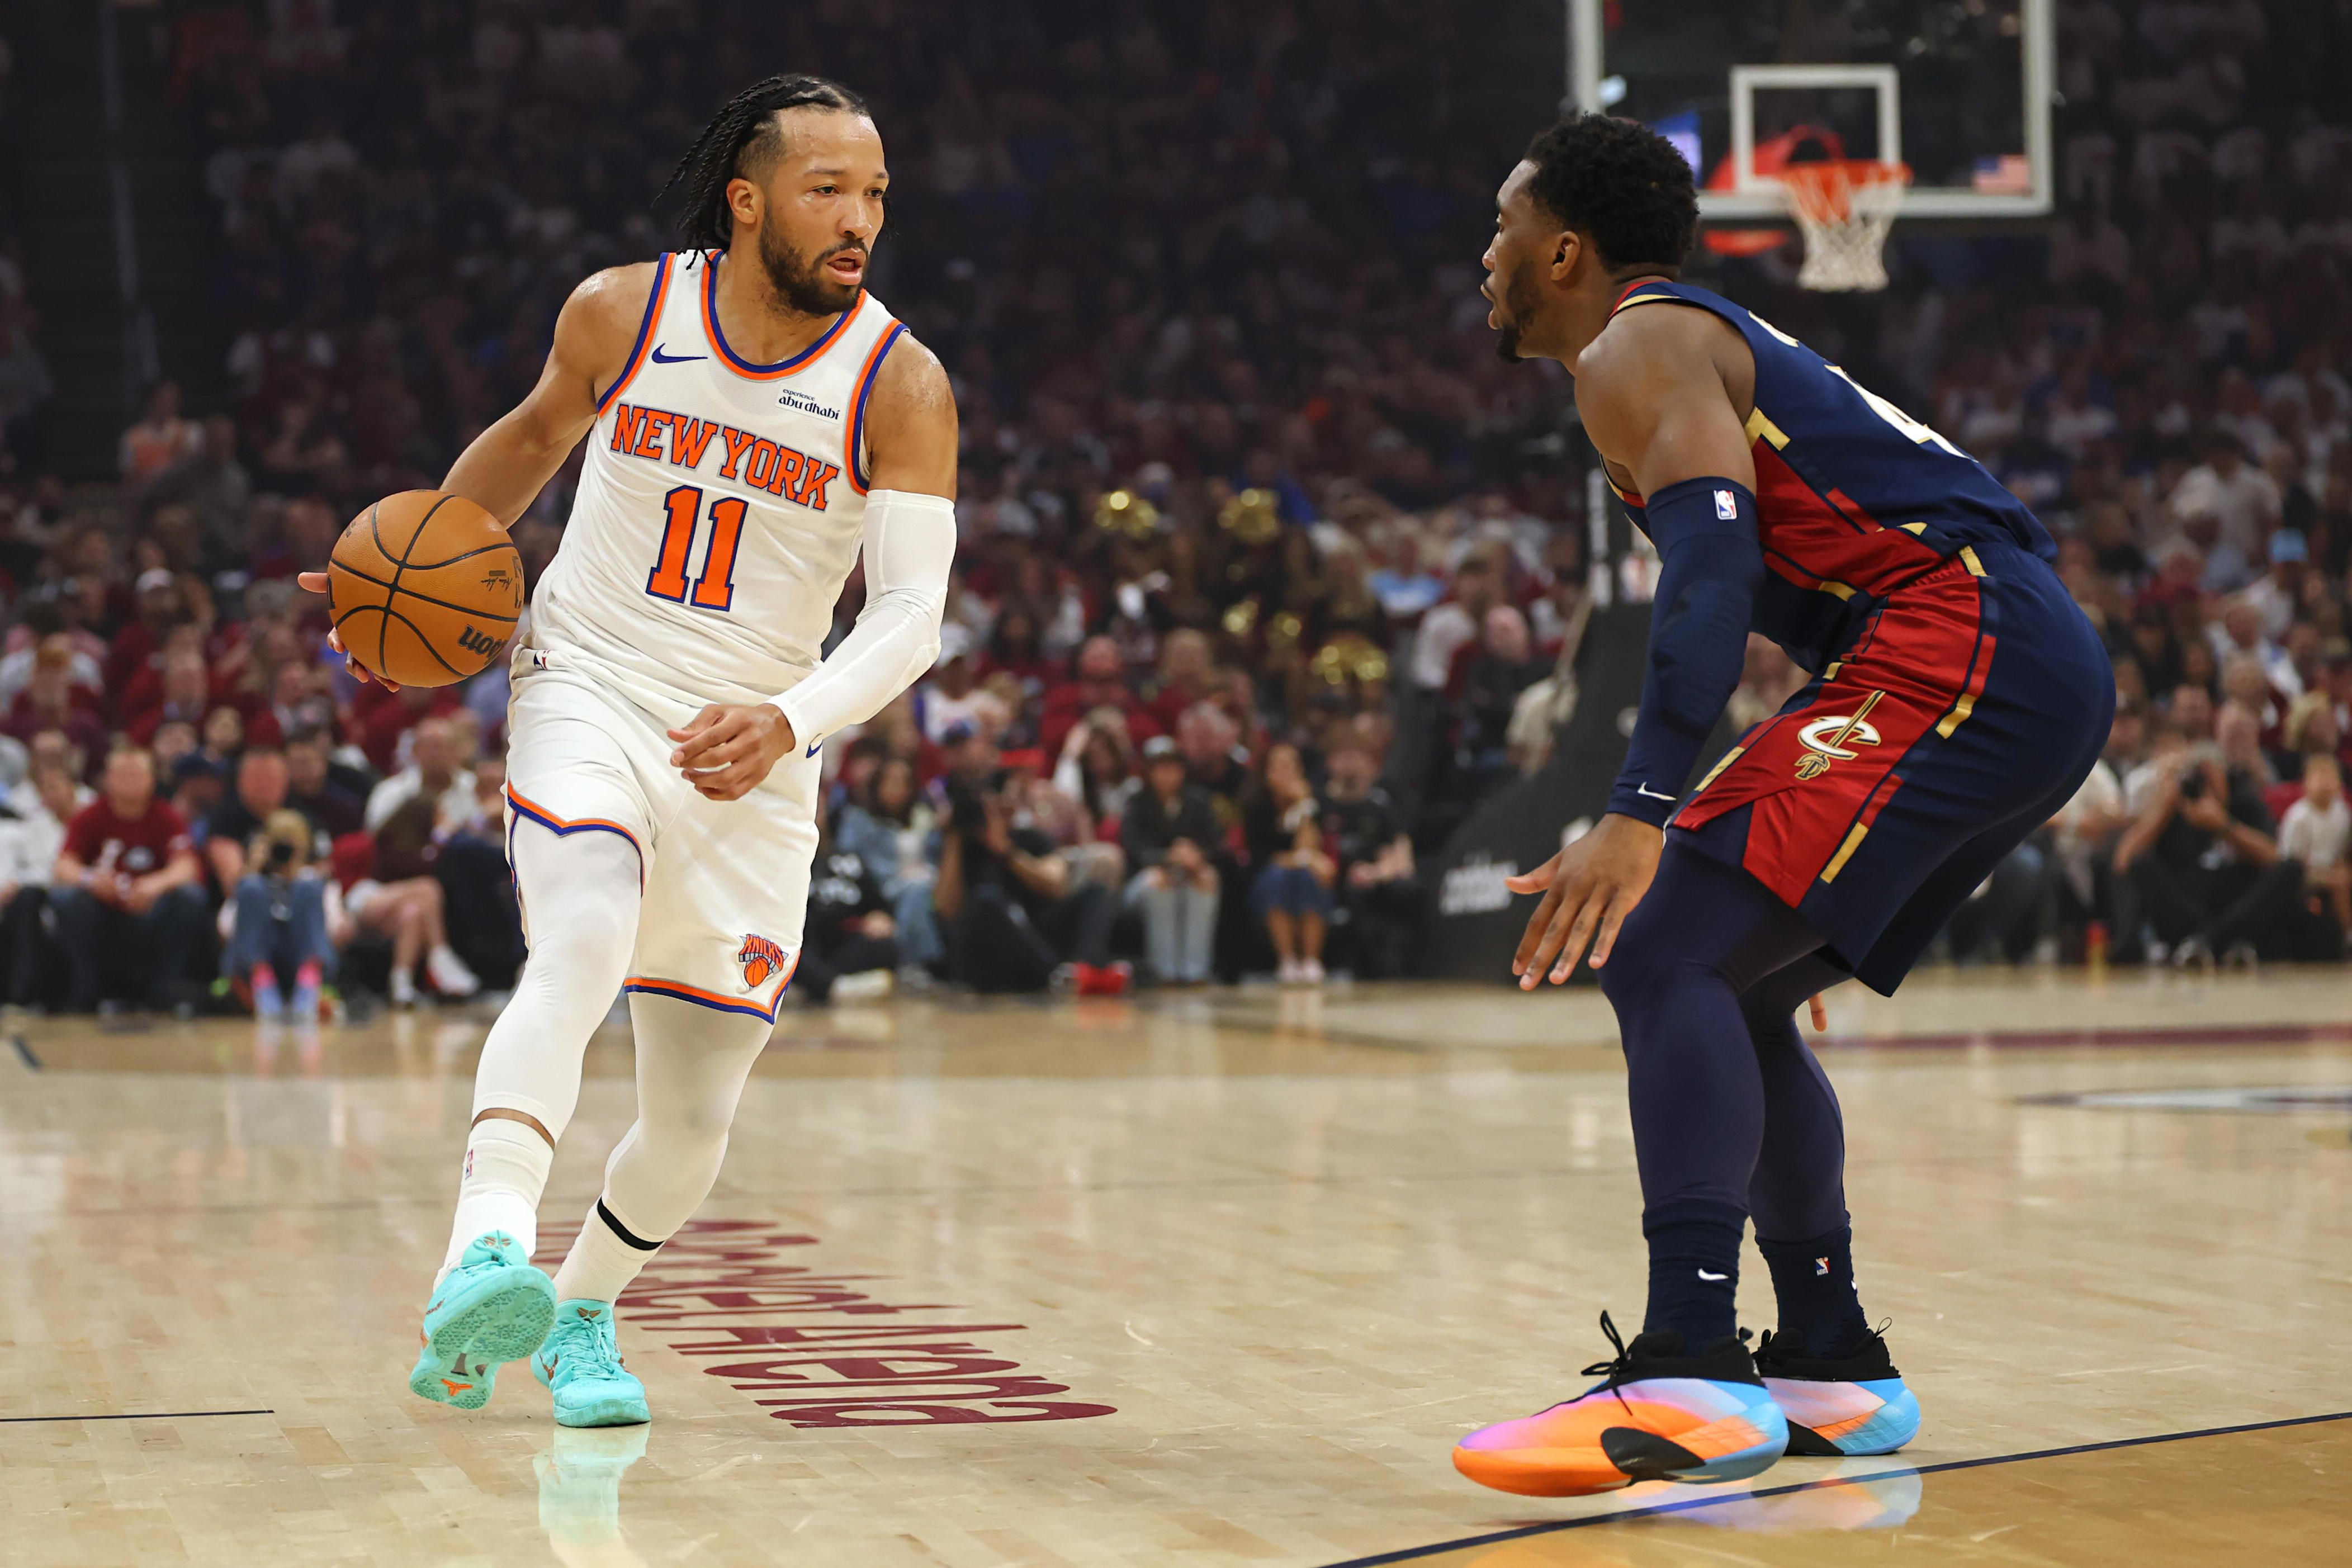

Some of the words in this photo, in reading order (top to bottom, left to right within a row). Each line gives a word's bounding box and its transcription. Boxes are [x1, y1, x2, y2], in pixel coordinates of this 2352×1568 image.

[779, 396, 803, 410] abu
[783, 389, 815, 401] experience
[610, 403, 720, 470] NEW
[718, 424, 841, 512] YORK
[646, 485, 749, 612] 11
[739, 934, 784, 971] KNICKS
[640, 1323, 1119, 1429] Arena
